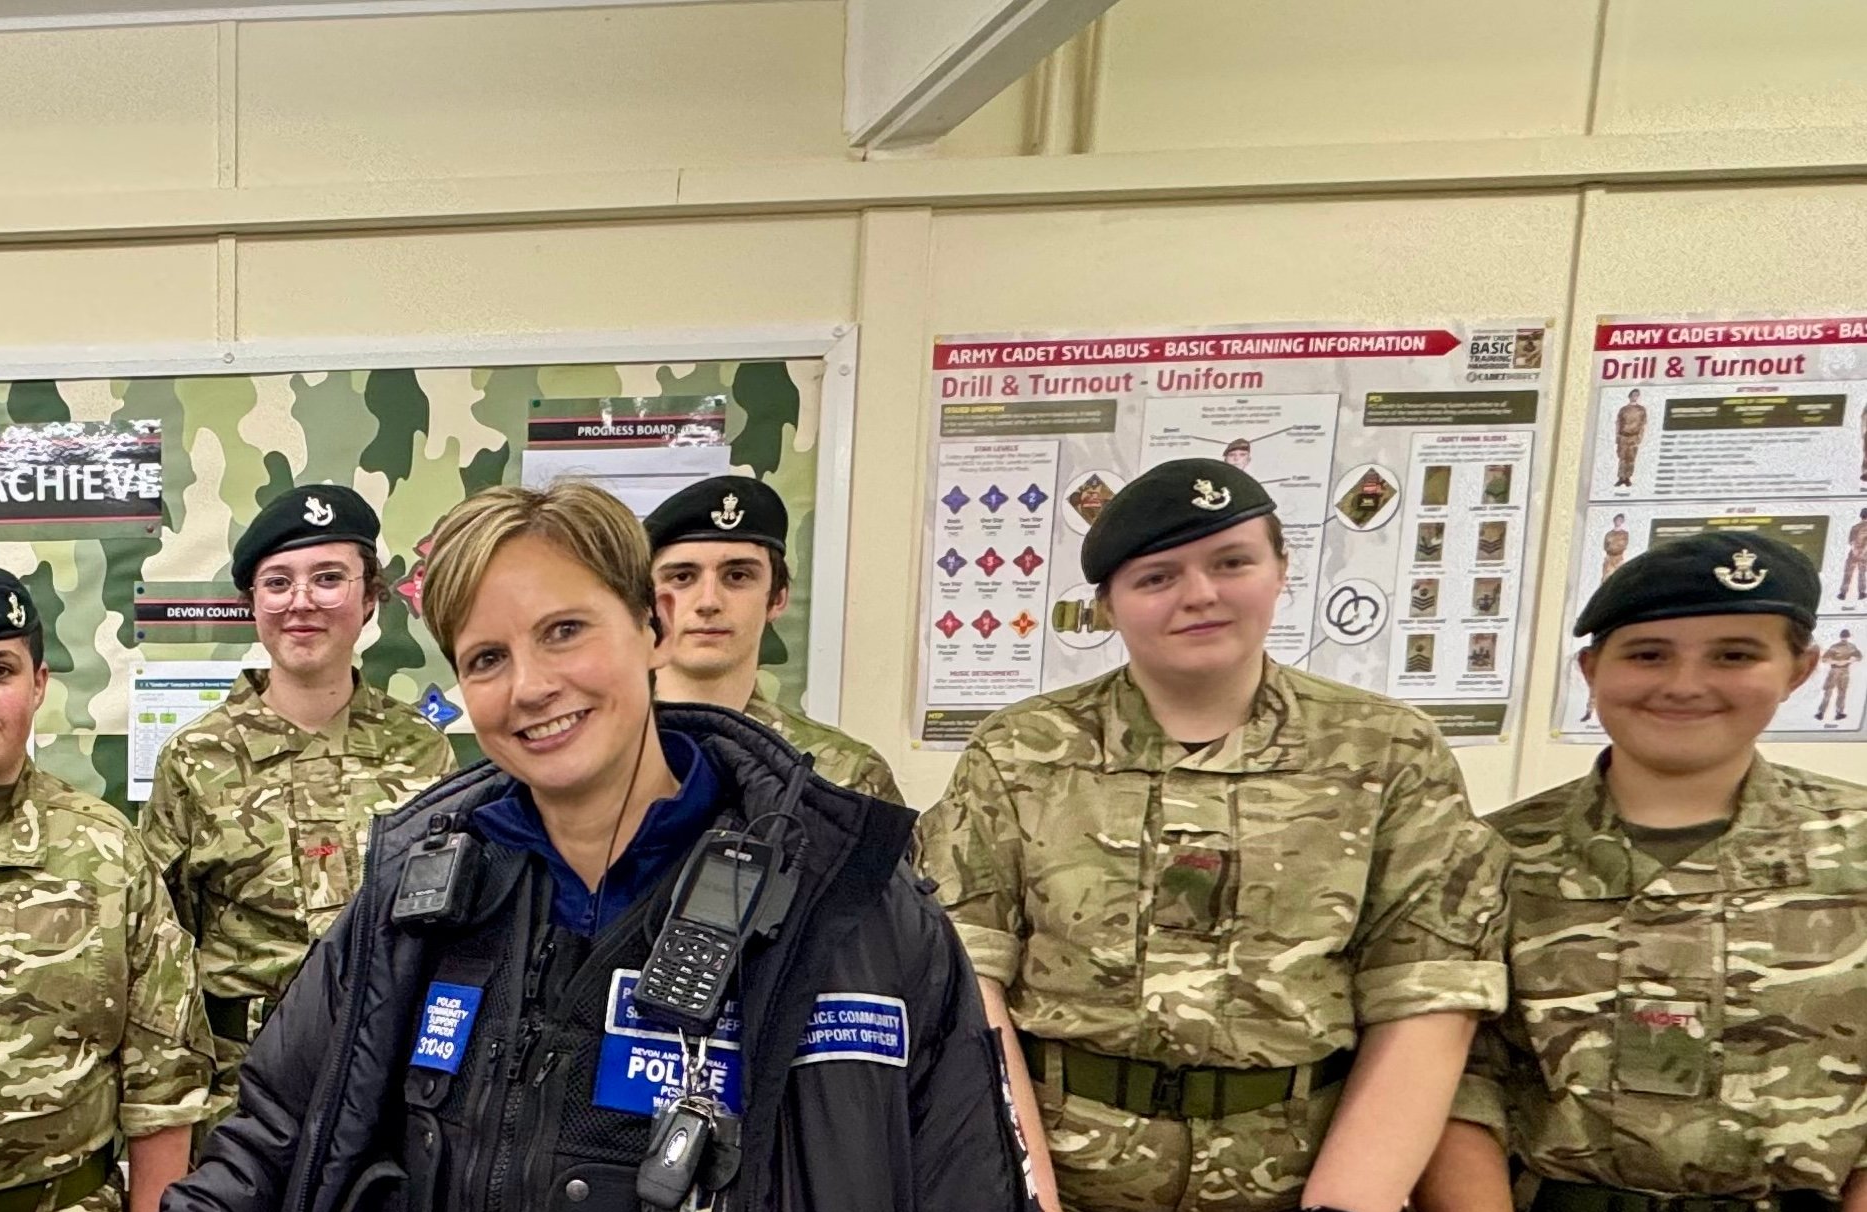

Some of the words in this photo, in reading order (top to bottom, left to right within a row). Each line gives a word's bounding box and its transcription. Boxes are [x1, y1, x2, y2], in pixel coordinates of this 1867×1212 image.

[1609, 328, 1663, 345] ARMY
[1667, 326, 1727, 343] CADET
[1730, 324, 1823, 341] SYLLABUS
[948, 347, 998, 365] ARMY
[1002, 345, 1056, 363] CADET
[1061, 342, 1149, 360] SYLLABUS
[1164, 339, 1215, 357] BASIC
[1220, 337, 1304, 355] TRAINING
[1308, 335, 1426, 353] INFORMATION
[1470, 342, 1513, 354] BASIC
[1601, 356, 1657, 380] Drill
[1665, 355, 1685, 378] &
[1694, 353, 1807, 377] Turnout
[941, 376, 992, 398] Drill
[1001, 374, 1019, 396] &
[1028, 371, 1133, 395] Turnout
[1156, 367, 1264, 392] Uniform
[577, 424, 634, 437] PROGRESS
[636, 423, 676, 435] BOARD
[167, 607, 204, 618] DEVON
[206, 607, 250, 618] COUNTY
[427, 702, 441, 723] 2
[838, 1009, 900, 1030] COMMUNITY
[417, 1036, 455, 1060] 31049
[798, 1028, 858, 1046] SUPPORT
[860, 1029, 899, 1047] OFFICER
[631, 1046, 661, 1059] DEVON
[662, 1052, 681, 1061] AND
[627, 1055, 728, 1094] POLCE
